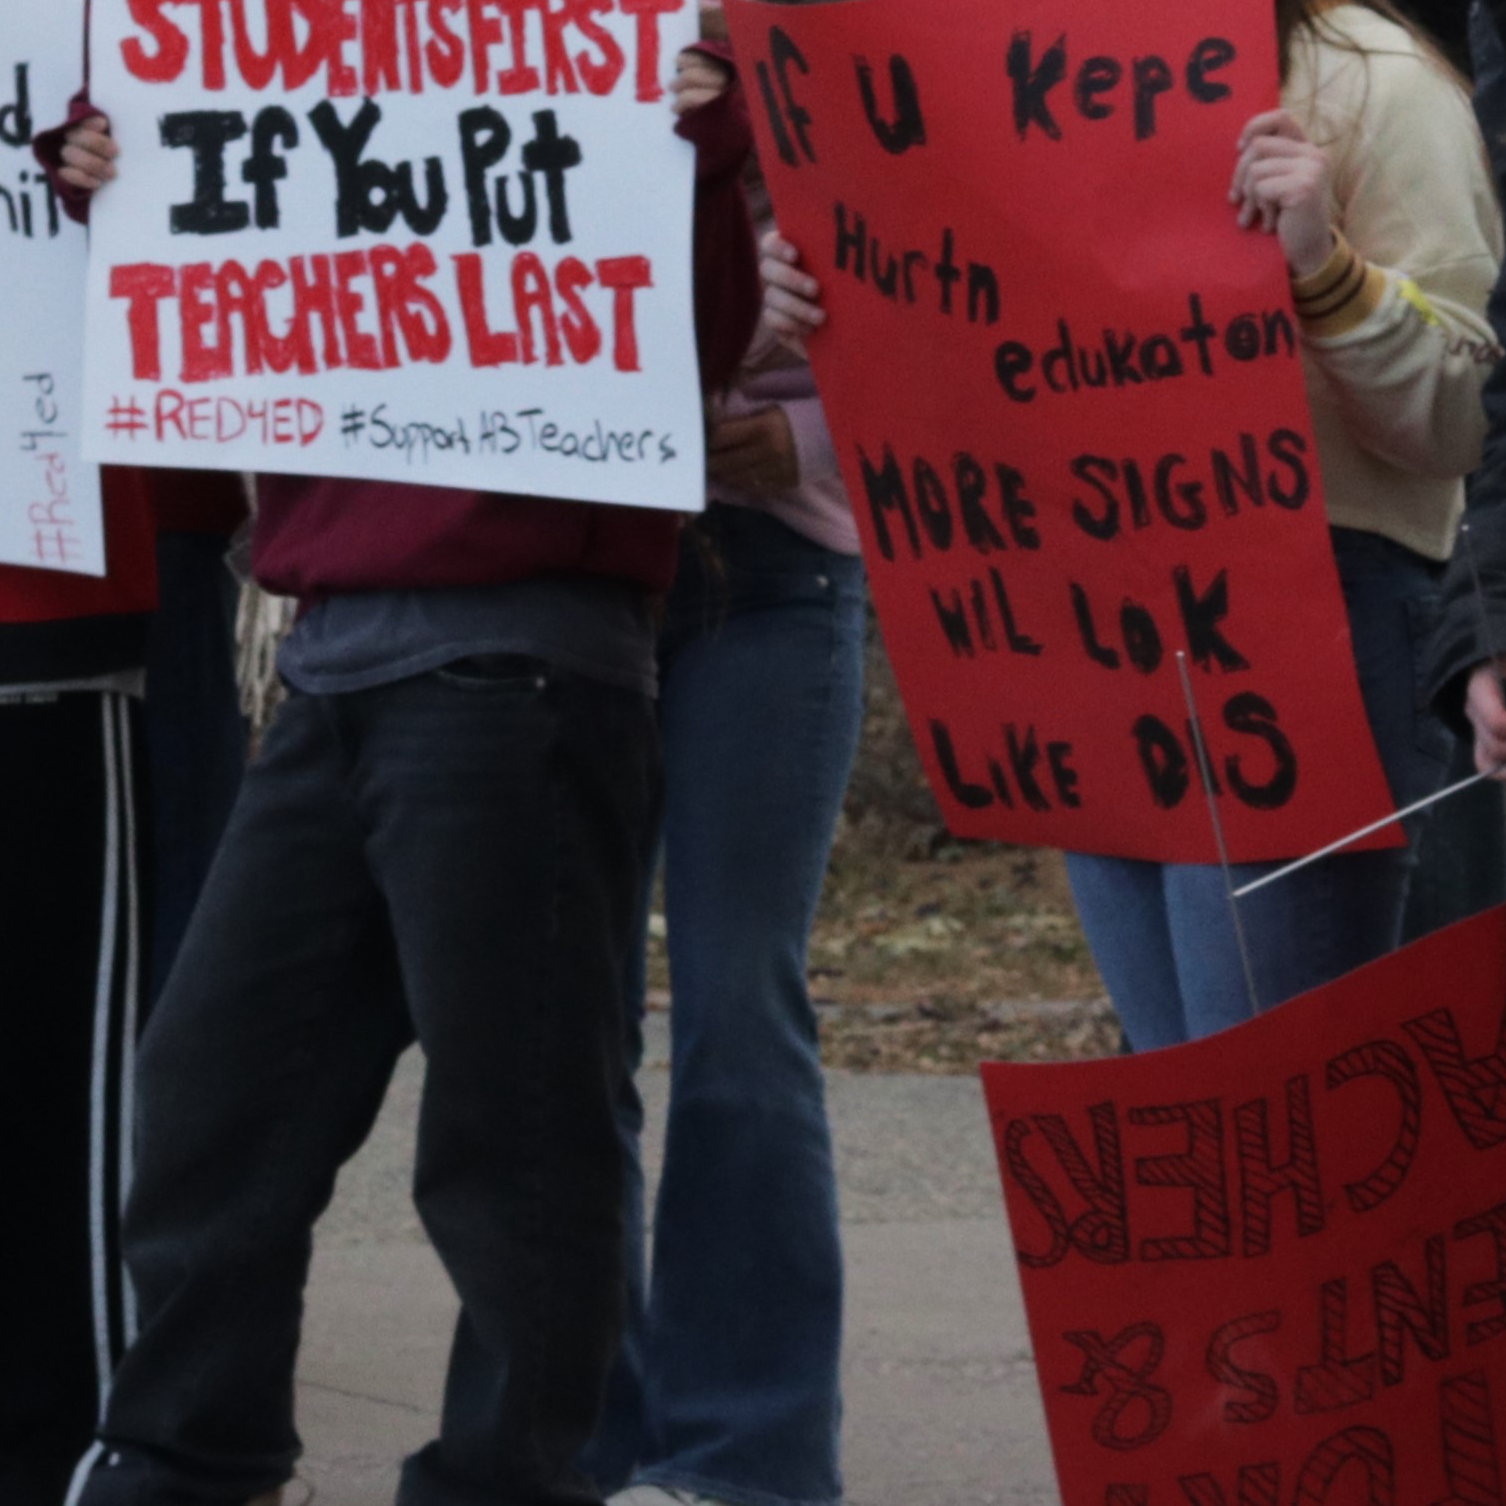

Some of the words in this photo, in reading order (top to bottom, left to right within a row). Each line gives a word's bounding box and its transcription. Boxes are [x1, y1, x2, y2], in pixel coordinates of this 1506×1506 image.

[157, 104, 299, 235] If
[306, 98, 448, 239] You
[457, 104, 583, 247] Put
[109, 241, 452, 384] TEACHERS
[450, 251, 654, 373] LAST
[105, 388, 325, 448] #RED4ED
[855, 440, 1042, 563] MORE
[1069, 428, 1311, 542] SIGNS
[927, 567, 1044, 659] WIL
[1068, 563, 1252, 676] LOK
[1131, 689, 1298, 812] DIS
